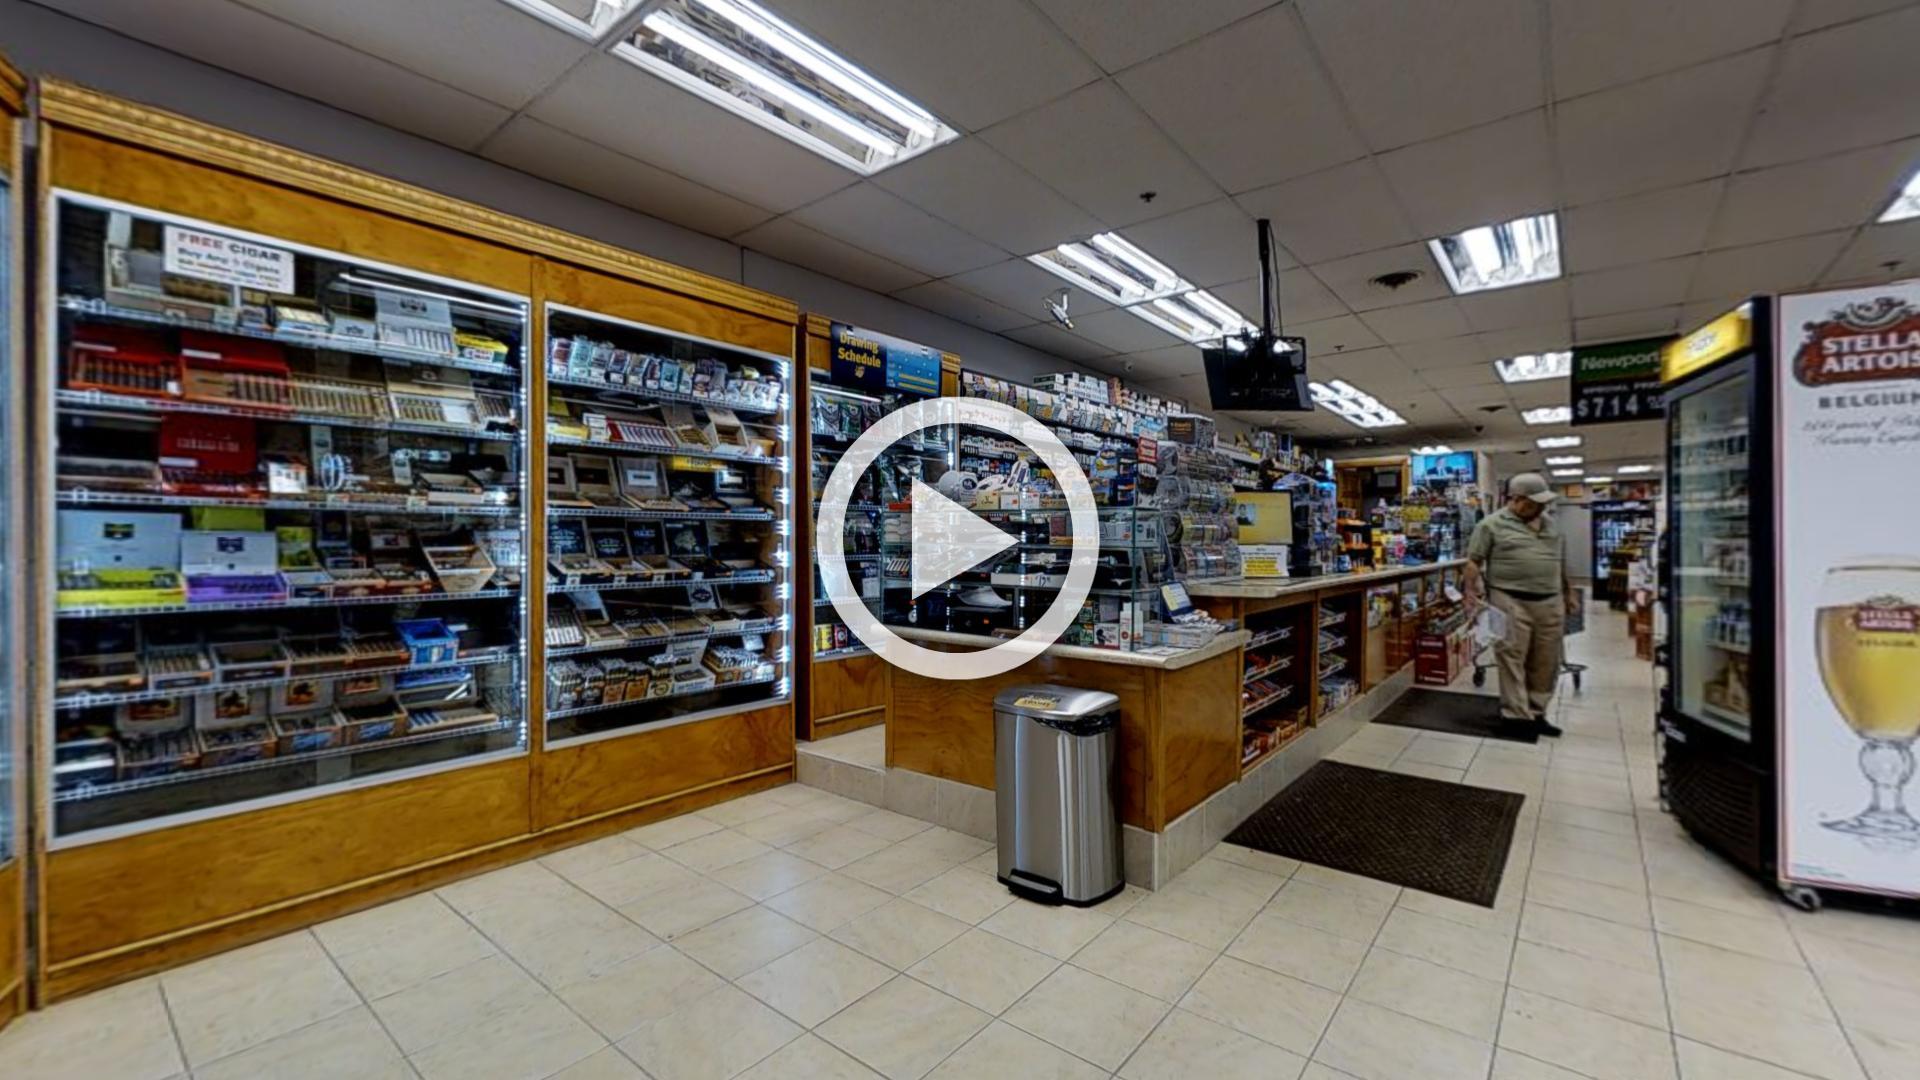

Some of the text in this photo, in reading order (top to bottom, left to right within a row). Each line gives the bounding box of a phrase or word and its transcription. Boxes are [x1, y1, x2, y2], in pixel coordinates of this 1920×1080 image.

[178, 232, 281, 261] FREE CIGAR
[840, 331, 879, 354] Drawing
[1822, 331, 1920, 355] STELLA
[838, 347, 881, 368] Schedule
[1822, 350, 1920, 373] ARTOIS
